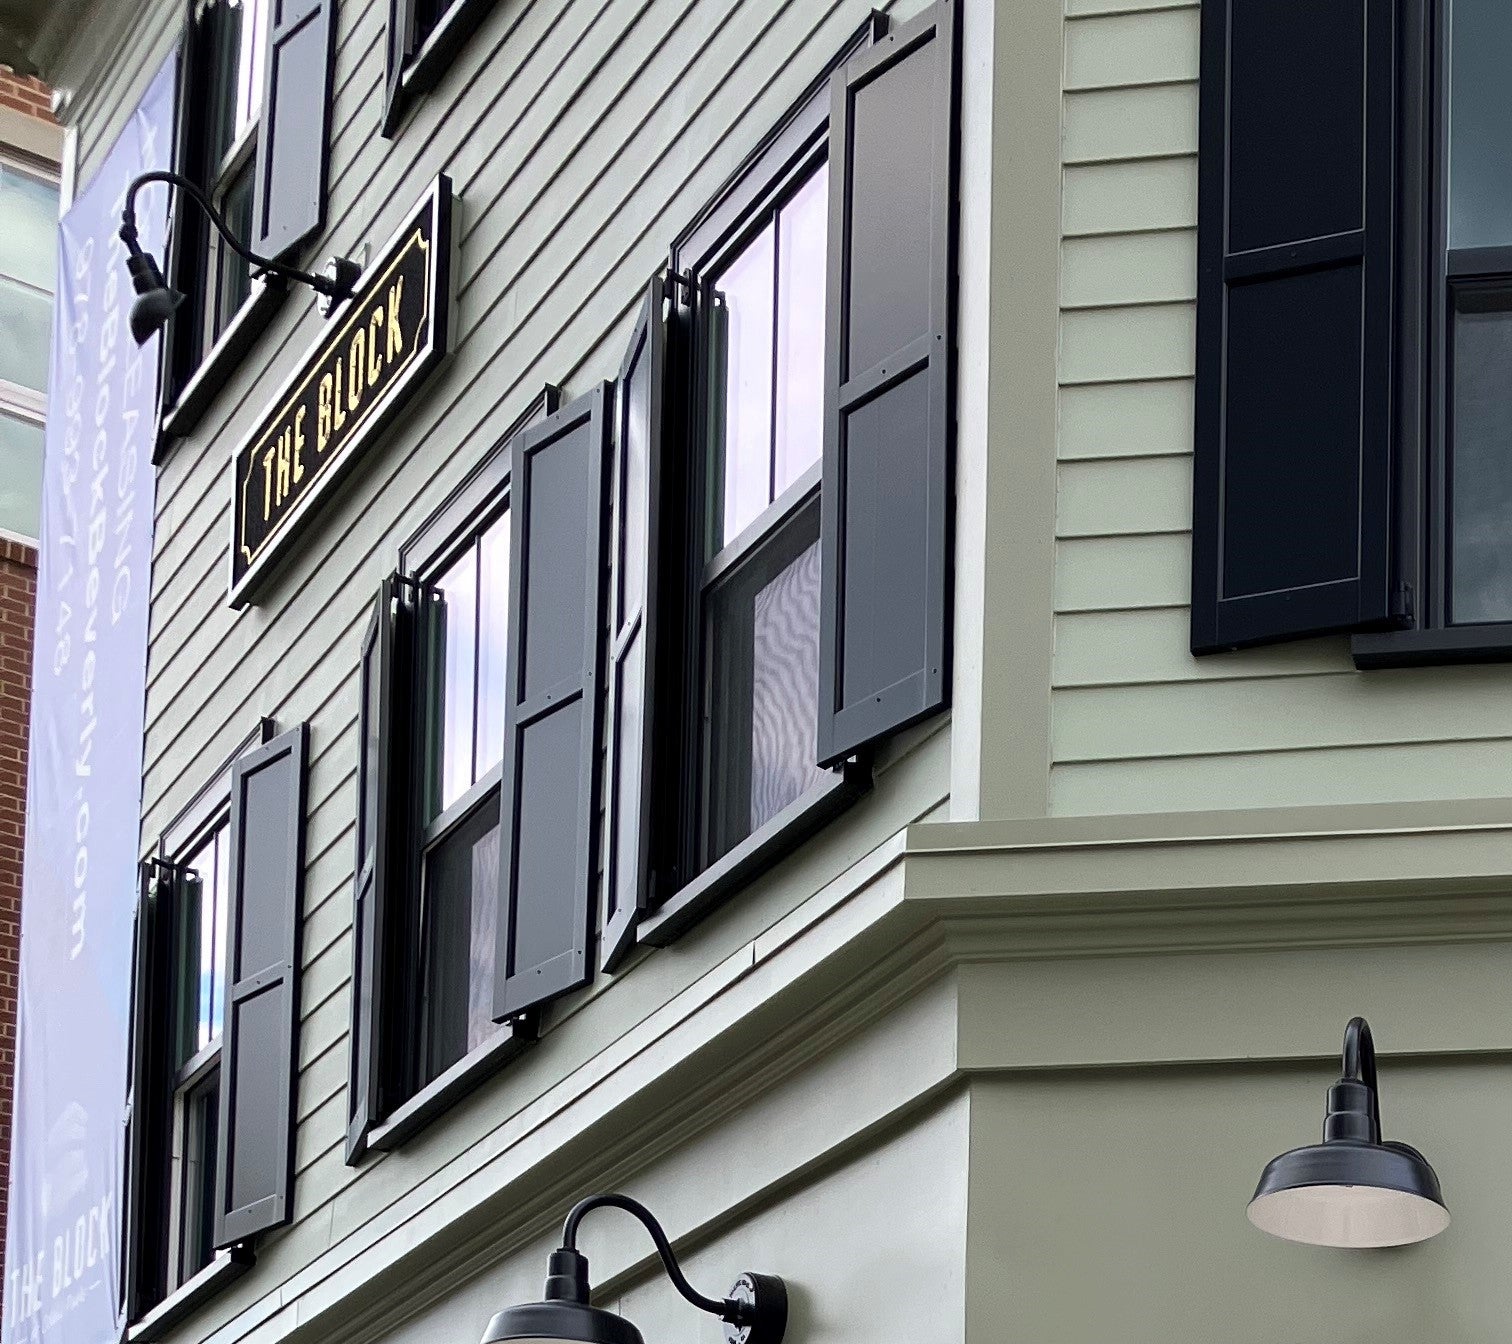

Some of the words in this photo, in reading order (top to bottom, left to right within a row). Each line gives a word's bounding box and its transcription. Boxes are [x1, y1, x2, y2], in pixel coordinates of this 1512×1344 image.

[111, 336, 143, 626] EASING
[261, 402, 306, 522] THE
[317, 273, 405, 443] BLOCK
[10, 1247, 46, 1328] THE
[52, 1190, 113, 1299] BLOCK
